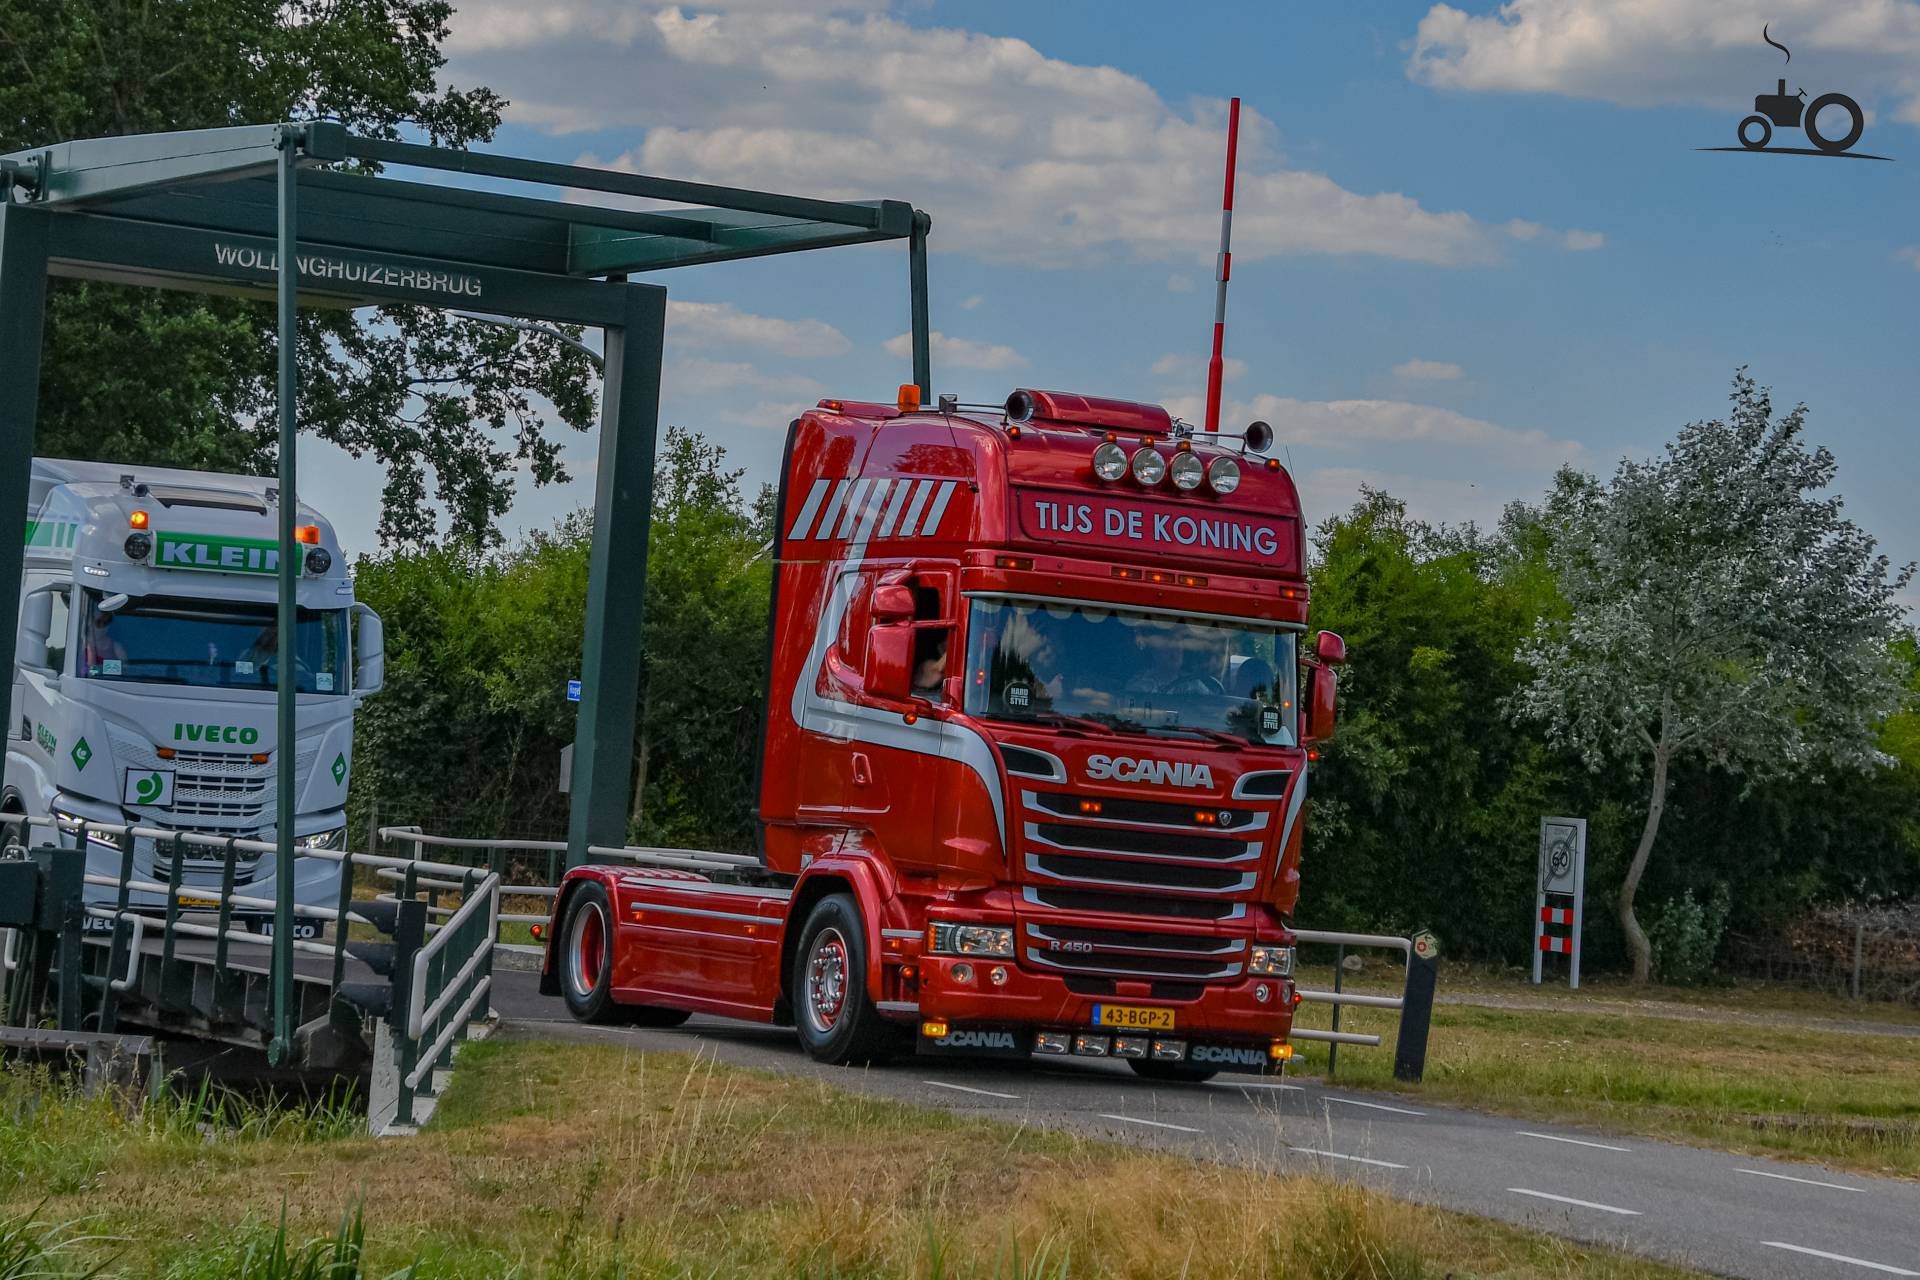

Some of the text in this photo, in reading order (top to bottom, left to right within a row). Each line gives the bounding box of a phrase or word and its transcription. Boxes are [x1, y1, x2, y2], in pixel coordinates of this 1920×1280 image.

[214, 243, 482, 297] WOLLNGHUIZERBRUG
[1035, 501, 1278, 556] TIJS DE KONING
[174, 723, 258, 745] IVECO
[1086, 754, 1215, 789] SCANIA
[1049, 940, 1093, 953] R 450
[1105, 1008, 1170, 1027] 43-BGP-2
[935, 1030, 1016, 1049] SCANIA
[1191, 1045, 1268, 1066] SCANIA
